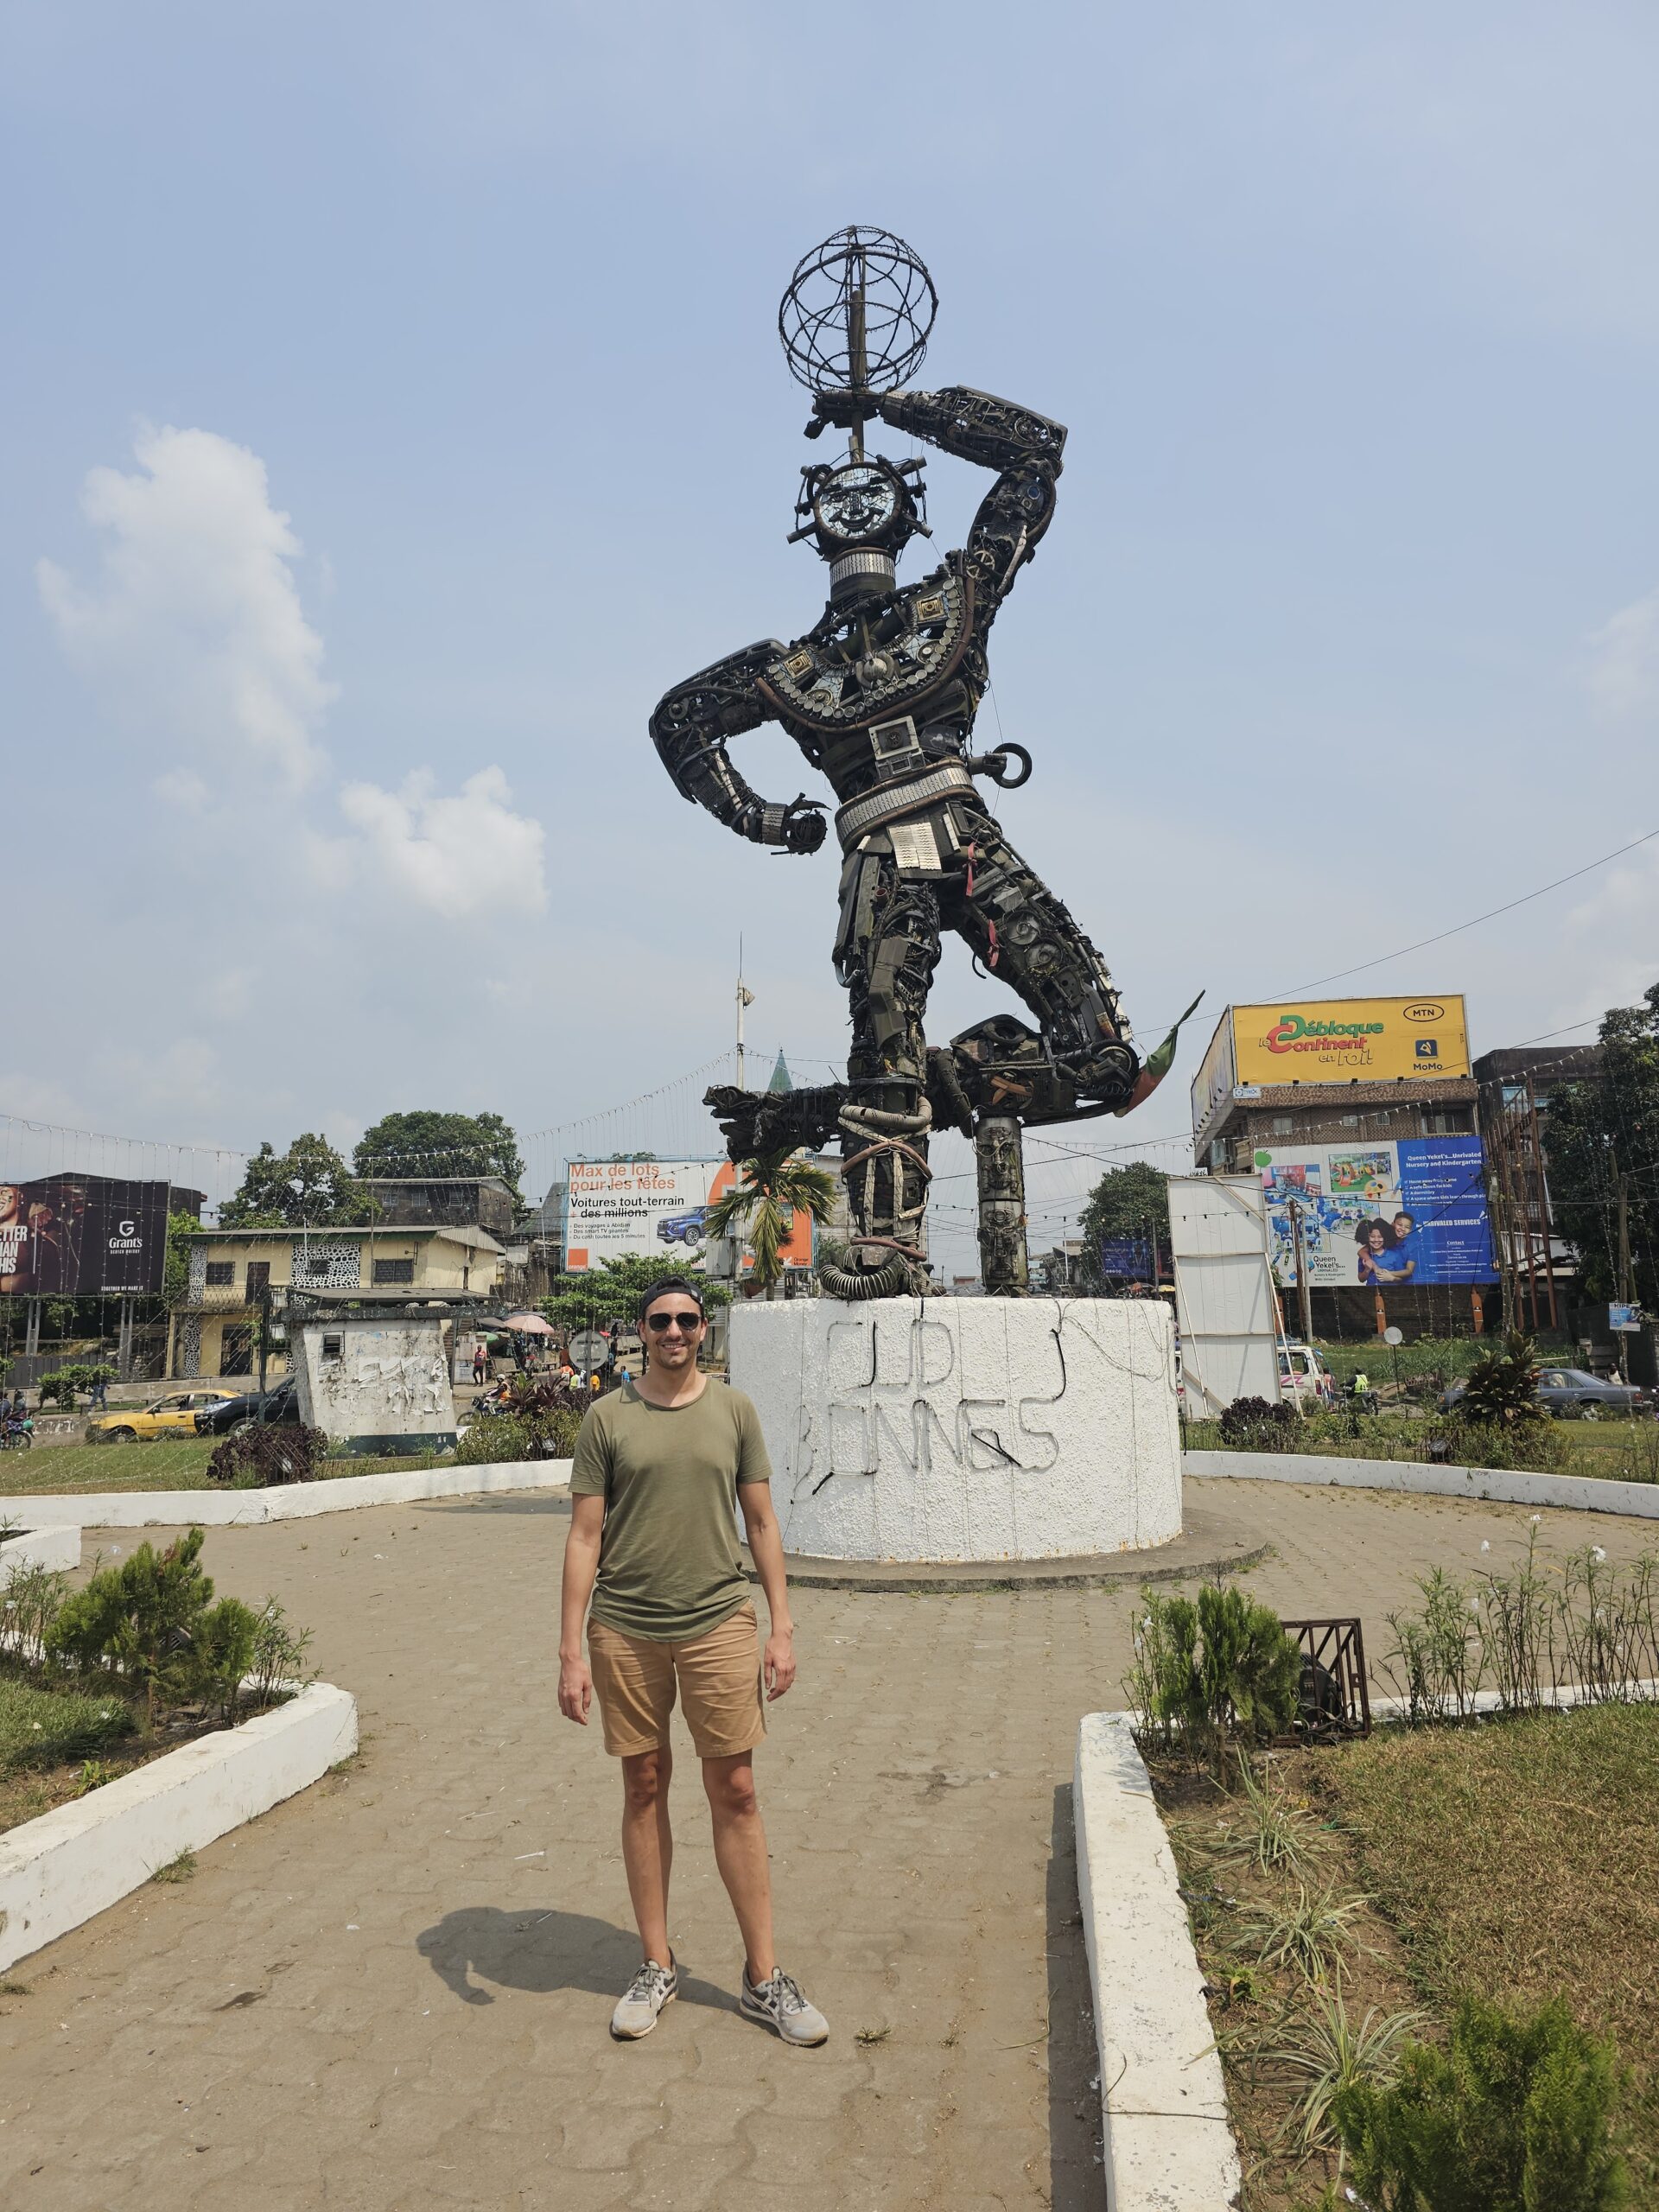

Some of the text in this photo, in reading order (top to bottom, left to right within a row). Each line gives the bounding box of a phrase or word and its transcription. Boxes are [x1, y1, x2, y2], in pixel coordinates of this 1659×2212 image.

[1413, 1008, 1434, 1017] MTN
[1279, 1014, 1384, 1040] Débloque
[1267, 1024, 1368, 1053] Continent
[1319, 1052, 1335, 1063] en
[571, 1162, 659, 1177] Max de lots
[570, 1177, 675, 1192] pour les fêtes
[571, 1196, 684, 1208] Voitures tout-terrain
[581, 1208, 601, 1218] des
[605, 1207, 648, 1217] millions
[109, 1237, 143, 1249] Grant's
